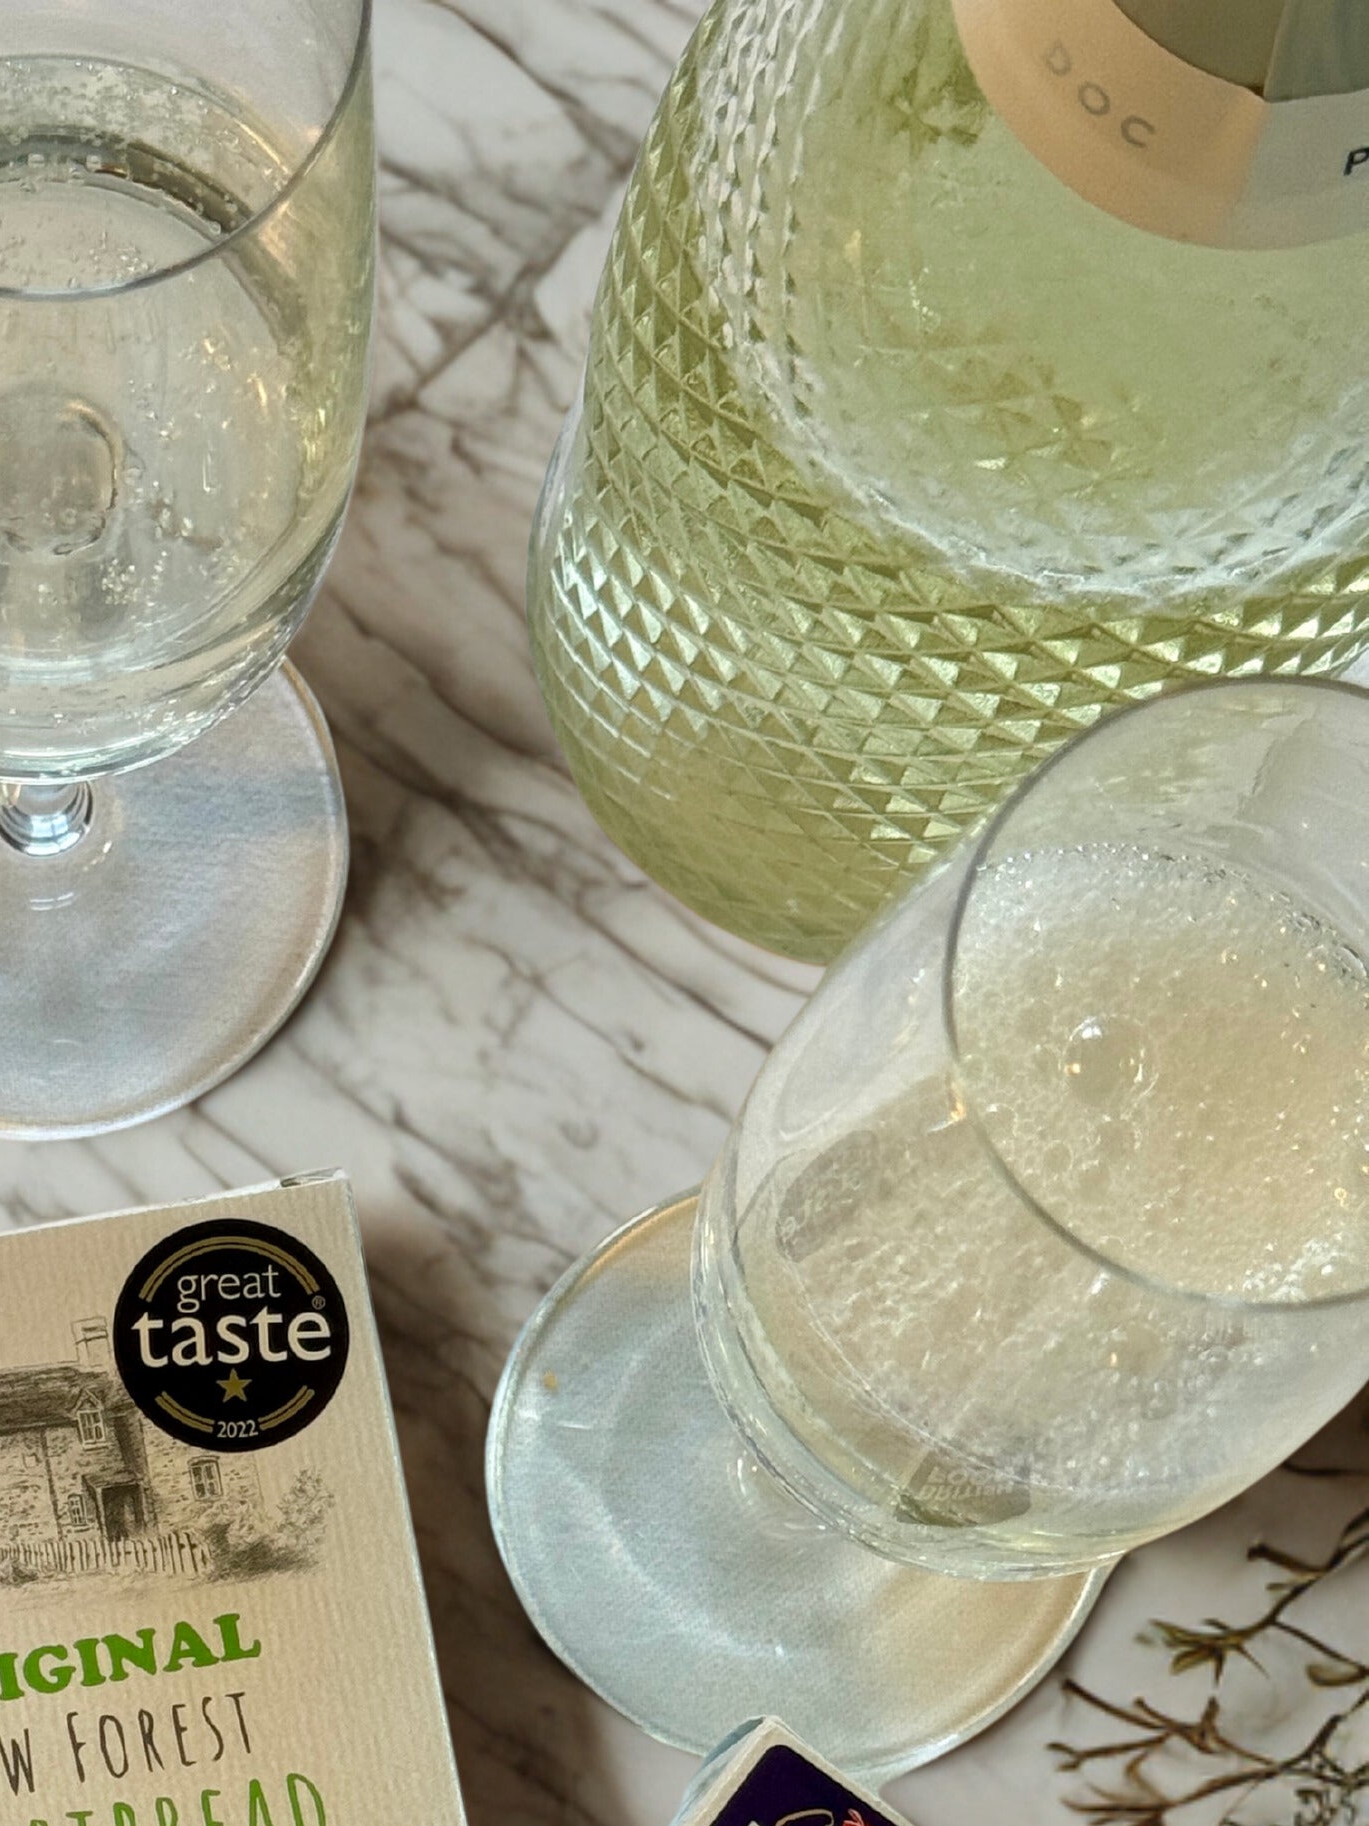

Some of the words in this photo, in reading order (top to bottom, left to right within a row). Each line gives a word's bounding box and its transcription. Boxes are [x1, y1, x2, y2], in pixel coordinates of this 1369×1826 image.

[1044, 38, 1156, 149] DOC
[177, 1264, 281, 1313] great
[131, 1305, 331, 1368] taste
[217, 1419, 259, 1438] 2022
[66, 1692, 252, 1783] FOREST
